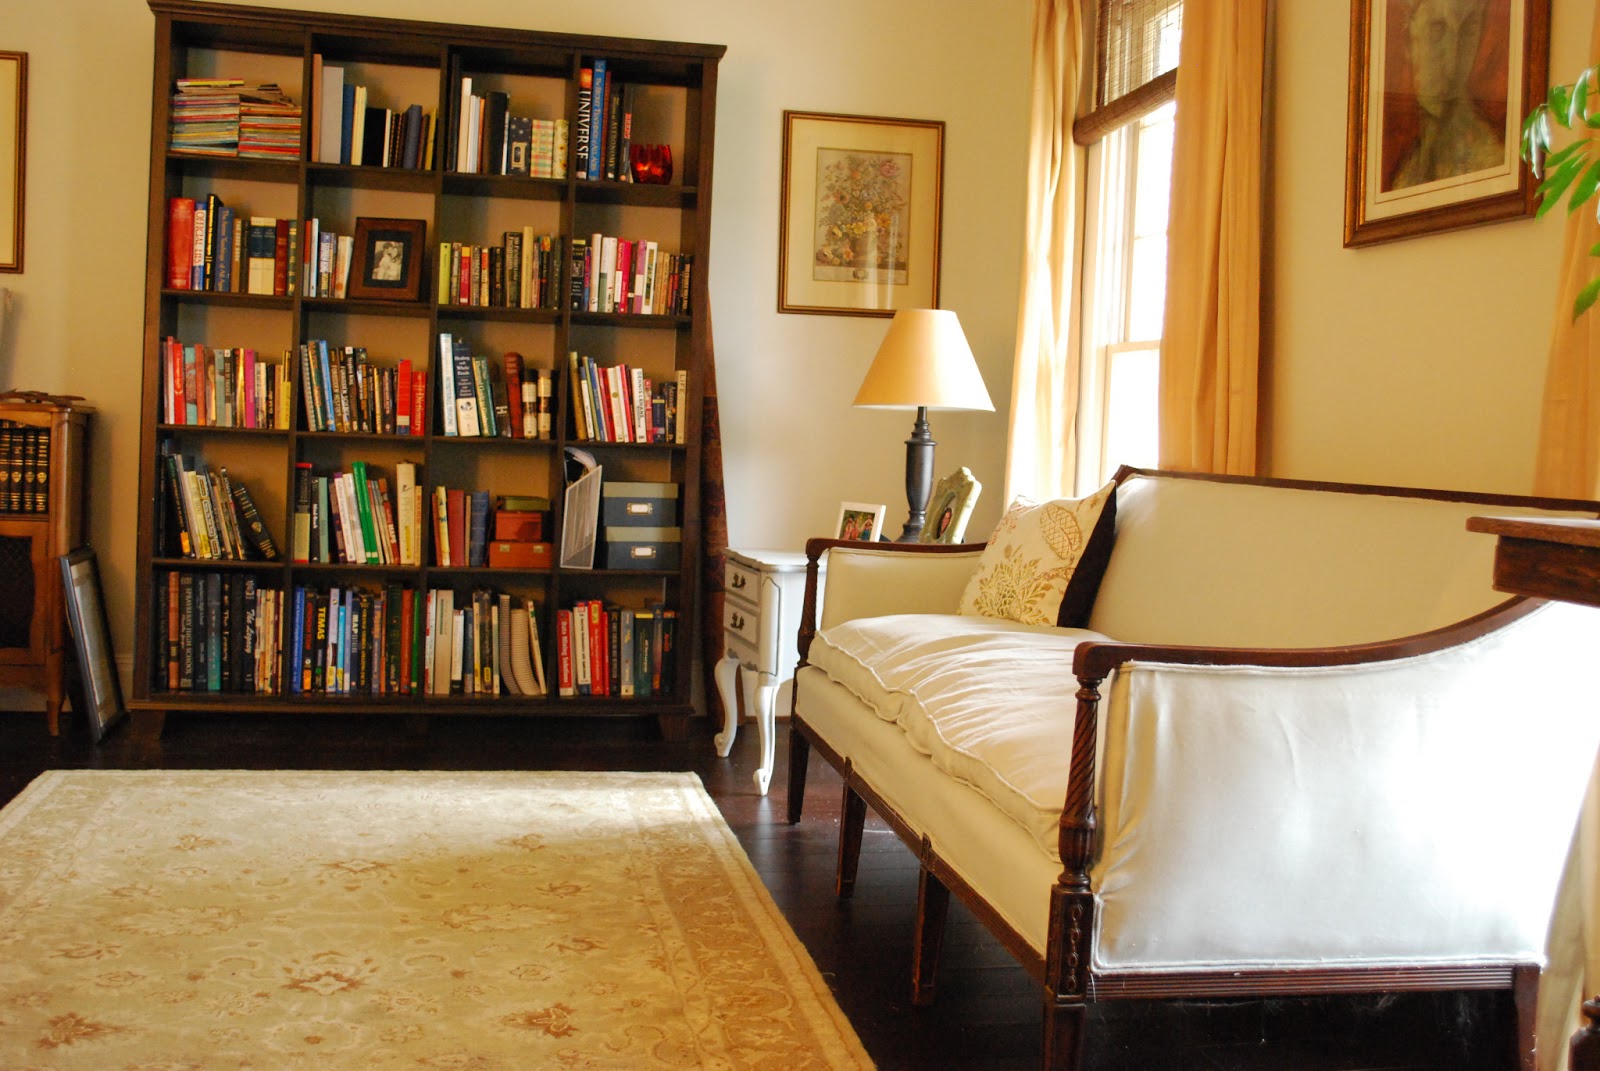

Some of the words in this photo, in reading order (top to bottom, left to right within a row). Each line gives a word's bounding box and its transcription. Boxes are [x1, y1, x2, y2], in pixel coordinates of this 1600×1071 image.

[577, 91, 591, 160] UNIVERSE
[609, 121, 618, 167] ASTRONOMY
[195, 211, 205, 246] OFFICIAL
[246, 609, 255, 624] The
[317, 607, 326, 640] TEMAS
[244, 625, 254, 653] Legacy
[561, 635, 569, 655] Mining
[562, 656, 570, 683] Solutions
